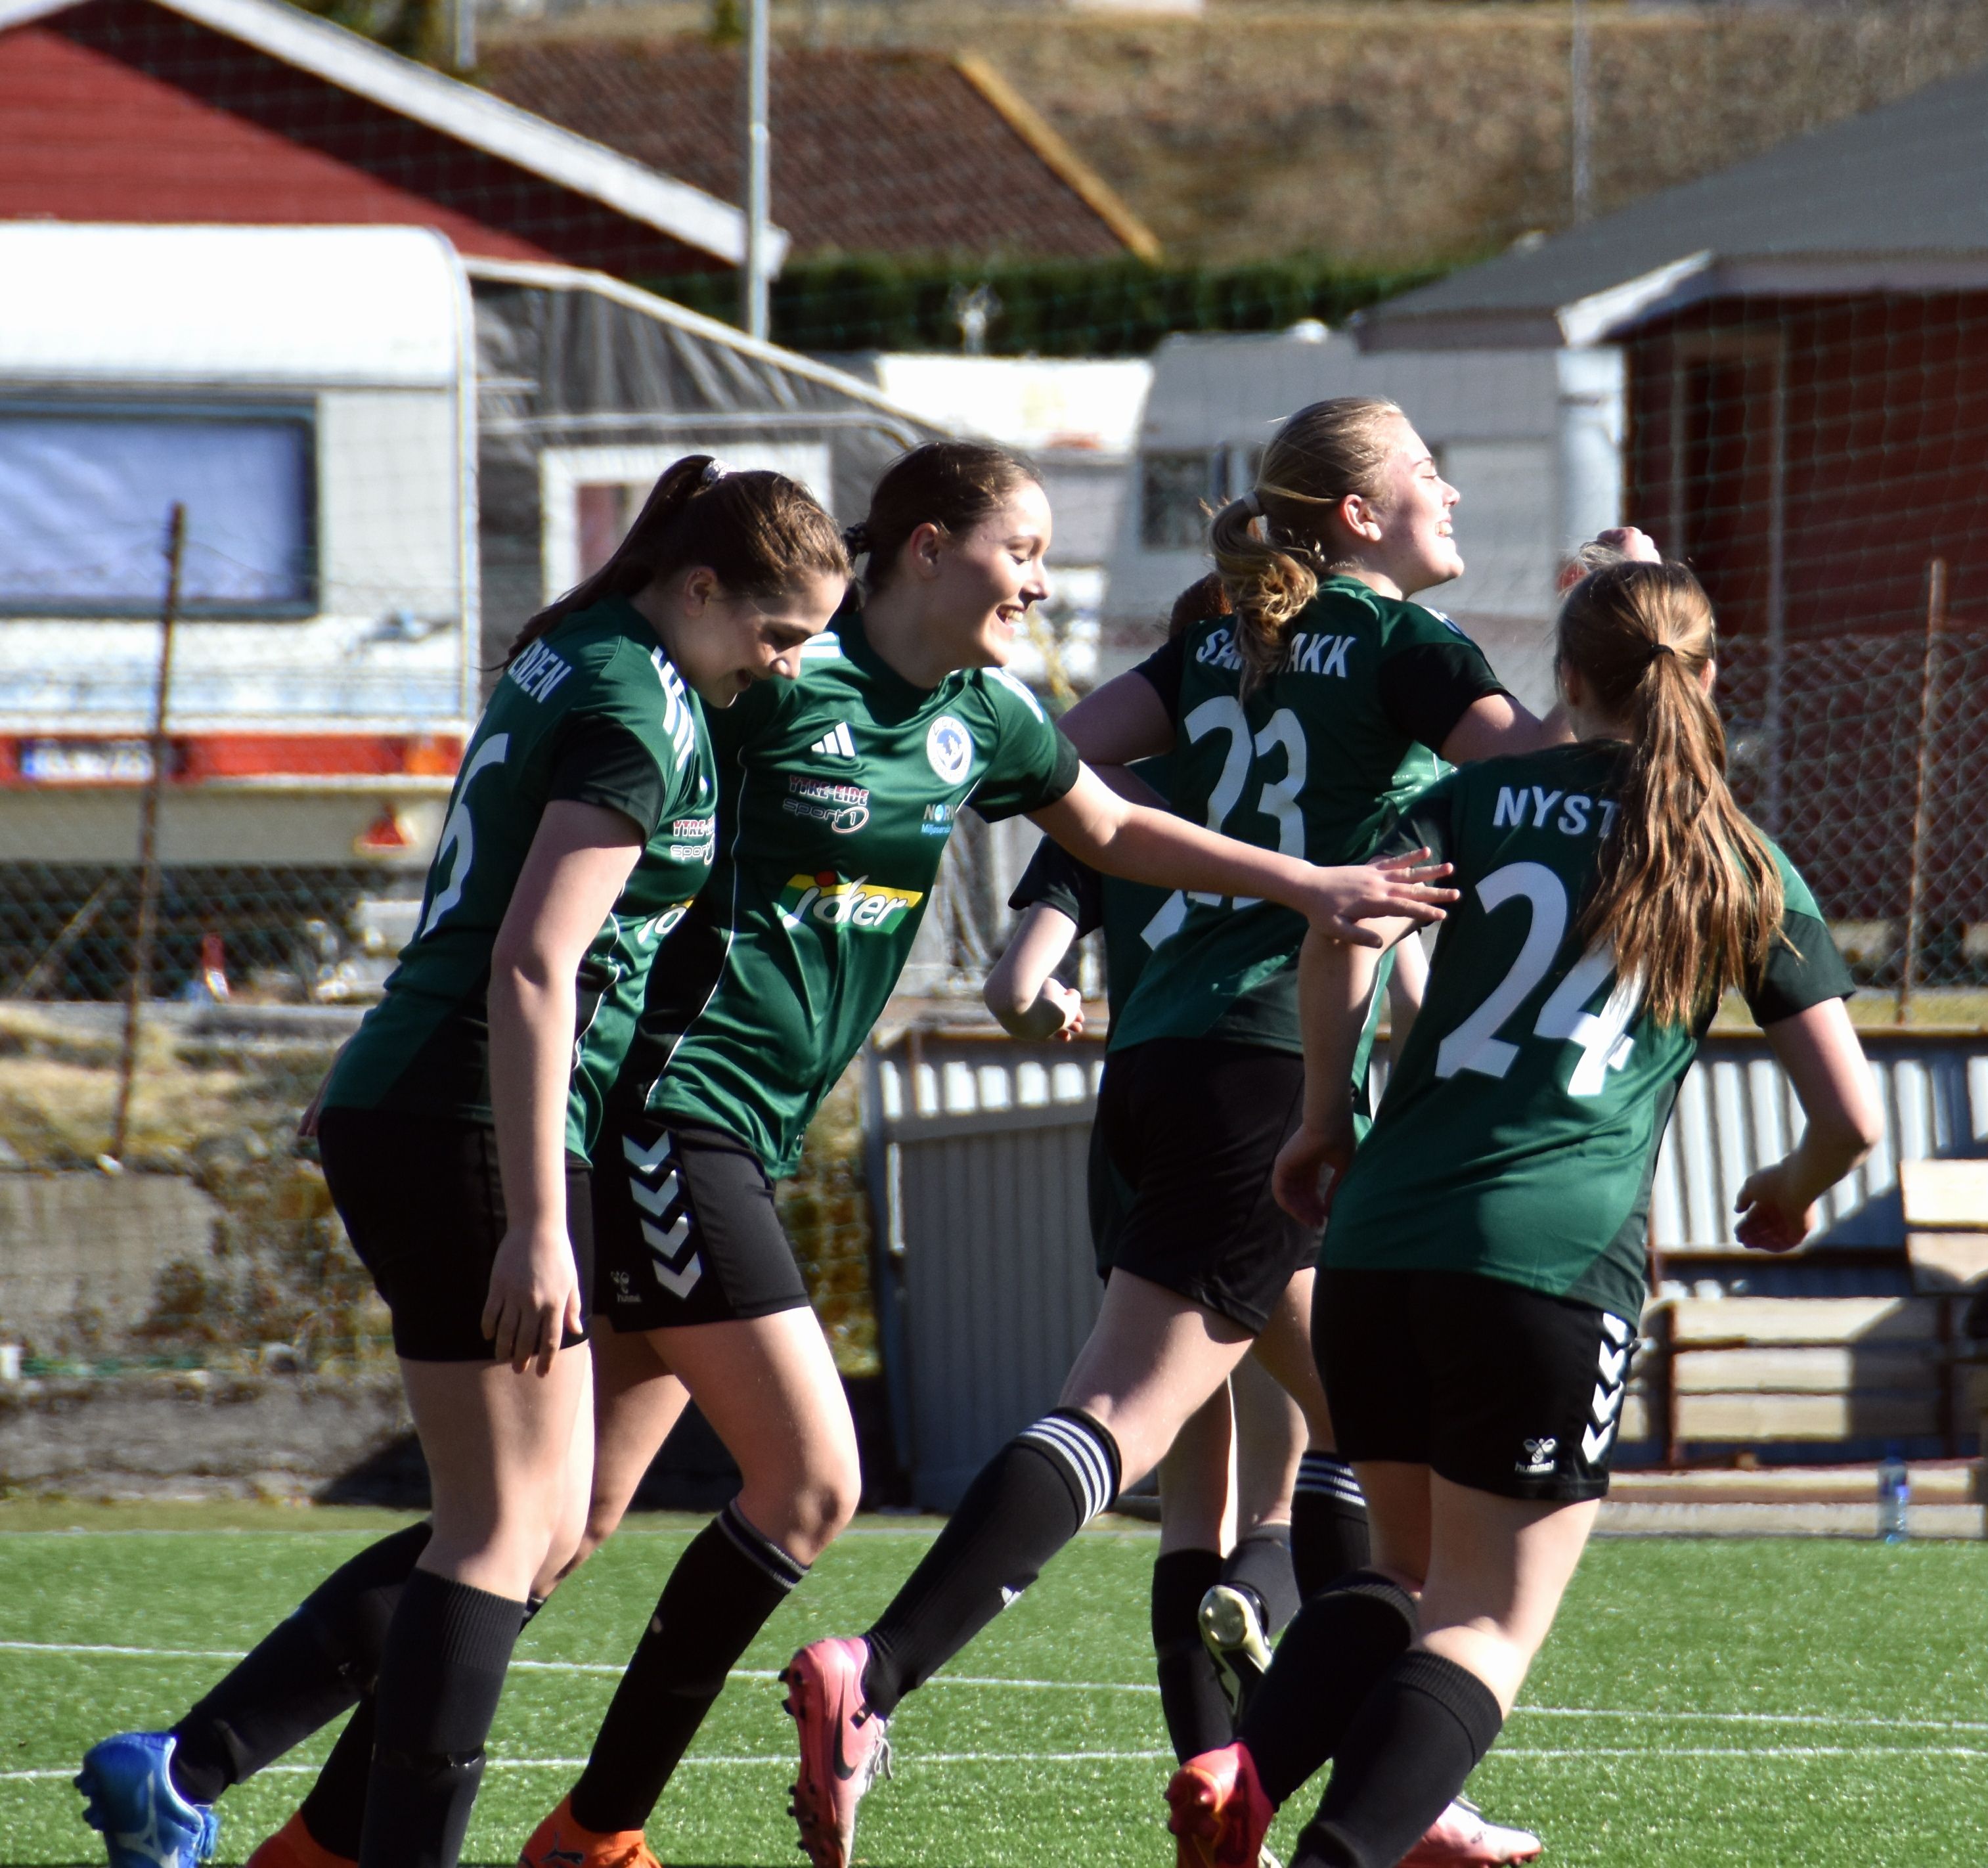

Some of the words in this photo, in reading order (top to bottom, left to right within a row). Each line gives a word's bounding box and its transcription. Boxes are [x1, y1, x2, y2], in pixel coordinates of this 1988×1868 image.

[1195, 629, 1356, 677] SAAKK
[789, 775, 869, 806] YTRE-EIDE
[1184, 696, 1307, 910] 23
[1493, 786, 1622, 838] NYST
[418, 729, 510, 938] 6
[1435, 861, 1647, 1096] 24
[1514, 1459, 1554, 1473] hummel
